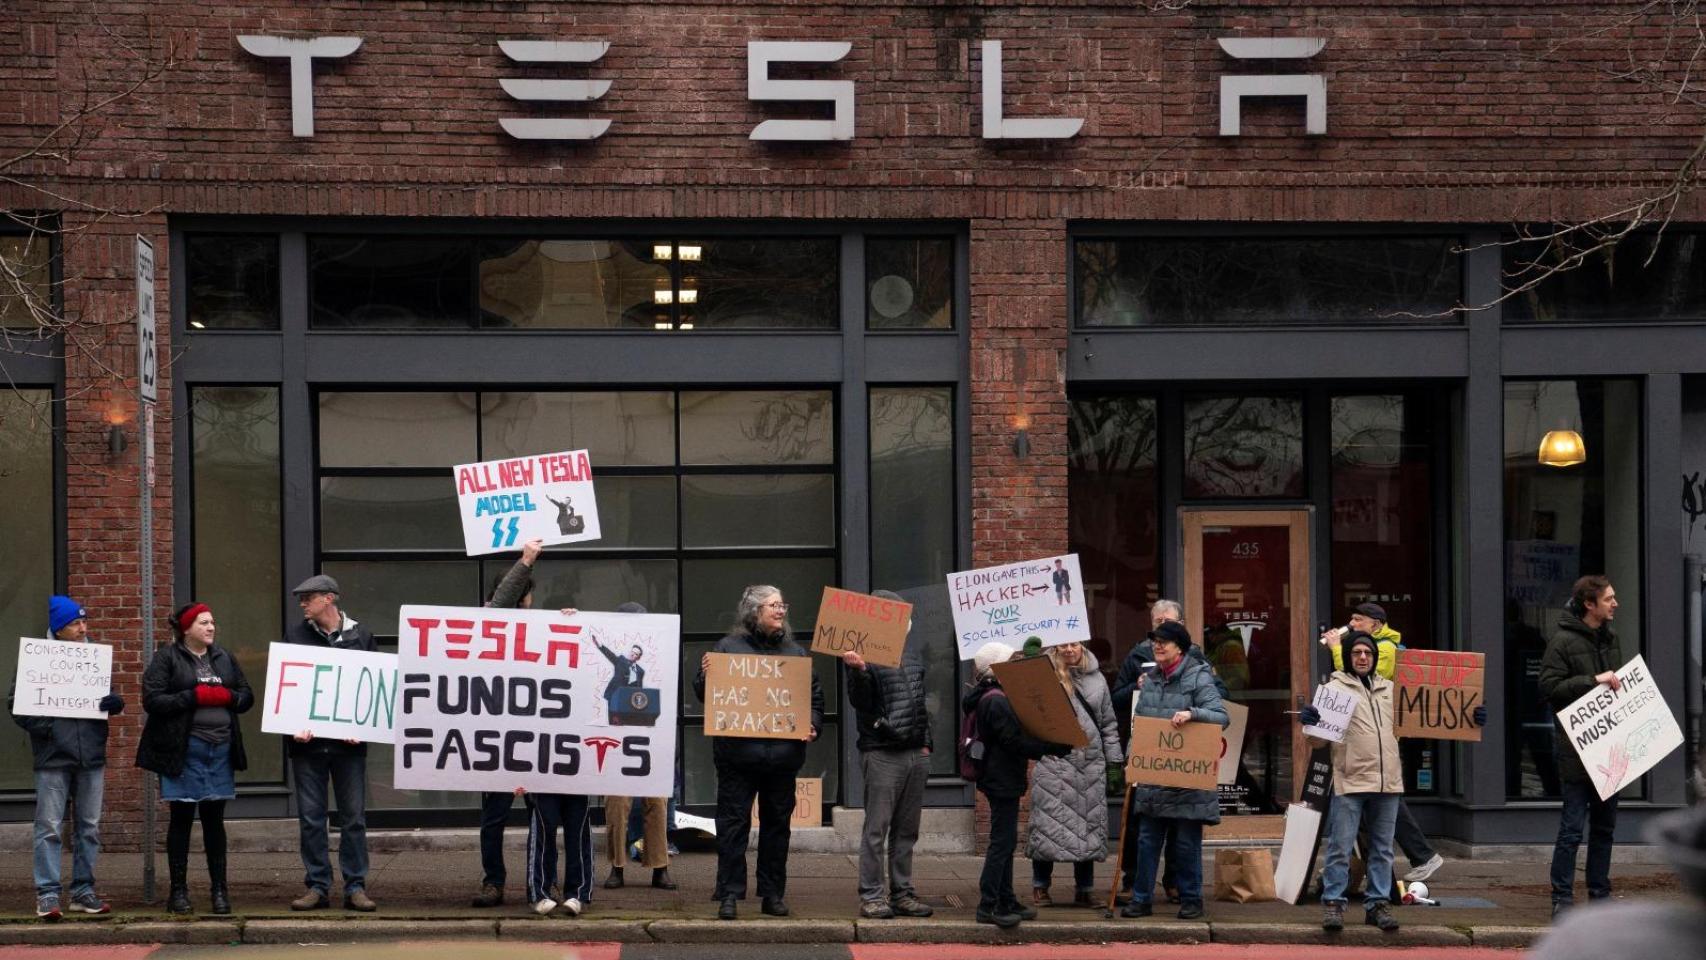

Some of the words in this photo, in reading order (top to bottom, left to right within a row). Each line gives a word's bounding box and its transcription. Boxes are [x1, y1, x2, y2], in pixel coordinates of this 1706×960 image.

[237, 35, 1327, 141] TESLA
[142, 327, 154, 387] 25
[459, 465, 497, 495] ALL
[499, 458, 533, 488] NEW
[539, 453, 592, 483] TESLA
[475, 492, 536, 517] MODEL
[1232, 542, 1259, 555] 435
[955, 572, 991, 590] ELON
[992, 570, 1017, 582] GAVE
[1020, 565, 1040, 577] THIS
[826, 592, 909, 623] ARREST
[958, 583, 1034, 612] HACKER
[982, 604, 1022, 623] YOUR
[1224, 612, 1269, 620] TESLA
[407, 618, 582, 669] TESLA
[962, 626, 1006, 647] SOCIAL
[1015, 618, 1060, 635] SECURITY
[24, 643, 89, 658] CONGRESS
[25, 670, 75, 684] SHOW
[82, 675, 110, 687] SOME
[49, 660, 100, 673] COURTS
[729, 656, 786, 678] MUSK
[1398, 651, 1477, 688] STOP
[274, 662, 398, 729] FELON
[403, 674, 572, 718] FUNDS
[713, 686, 749, 706] HAS
[766, 687, 791, 707] NO
[1399, 686, 1478, 730] MUSK
[1569, 686, 1619, 730] ARREST
[1620, 667, 1644, 693] THE
[715, 711, 796, 733] BRAKES
[1575, 685, 1657, 751] MUSKETEERS
[403, 728, 650, 776] FASCISTS
[1158, 731, 1184, 750] NO
[1131, 755, 1218, 776] OLIGARCHY!
